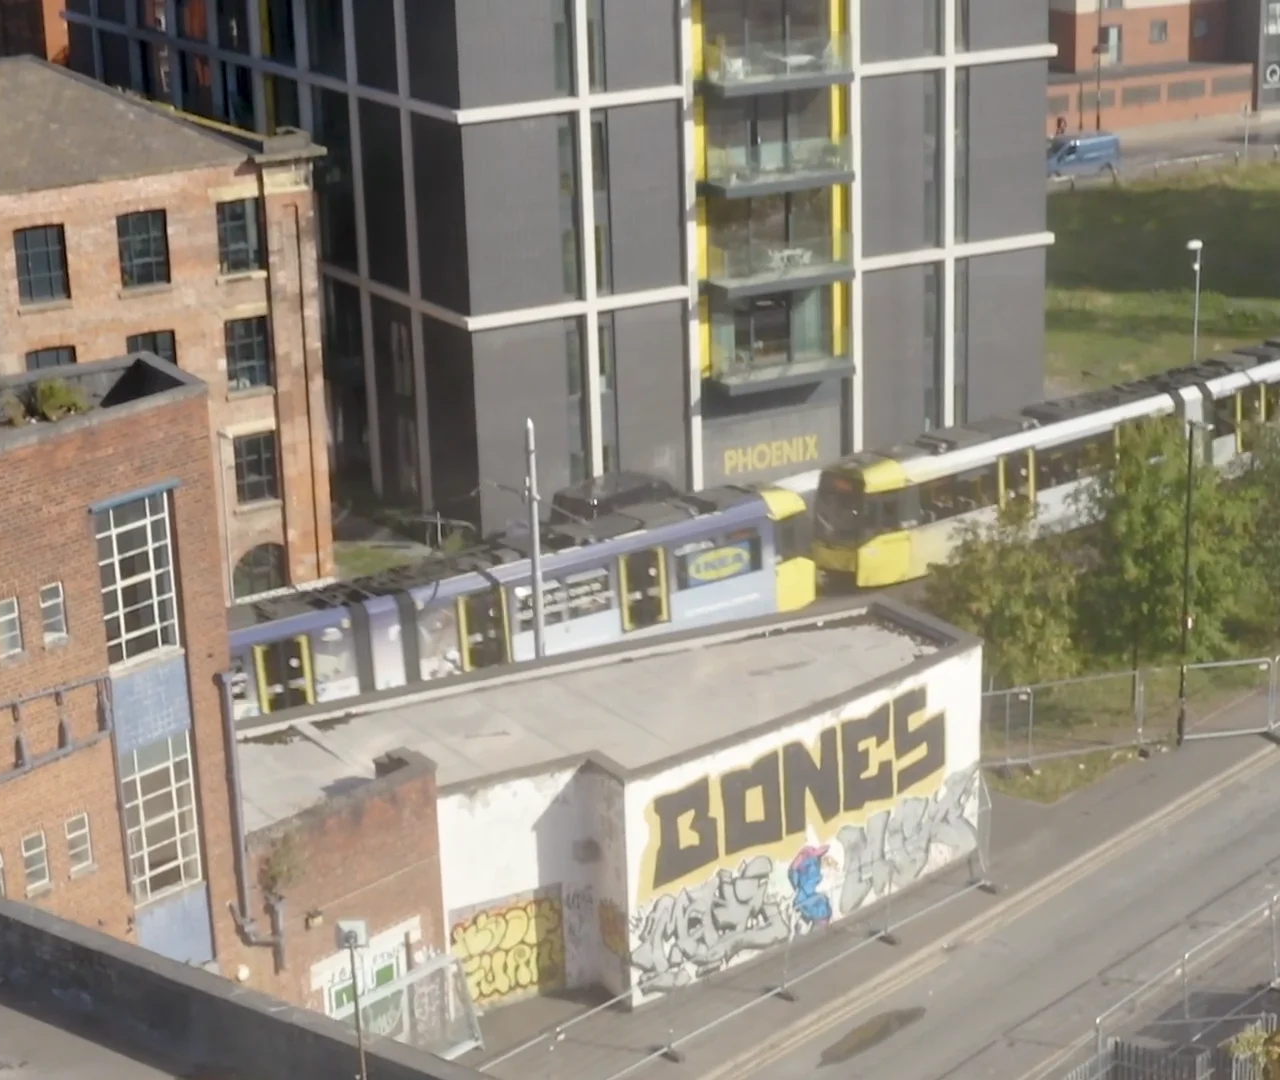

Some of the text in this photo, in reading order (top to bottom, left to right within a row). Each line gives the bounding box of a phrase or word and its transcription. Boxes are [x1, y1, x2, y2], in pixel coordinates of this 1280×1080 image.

[723, 434, 818, 475] PHOENIX
[695, 553, 745, 574] IKEA
[652, 683, 946, 890] BONES
